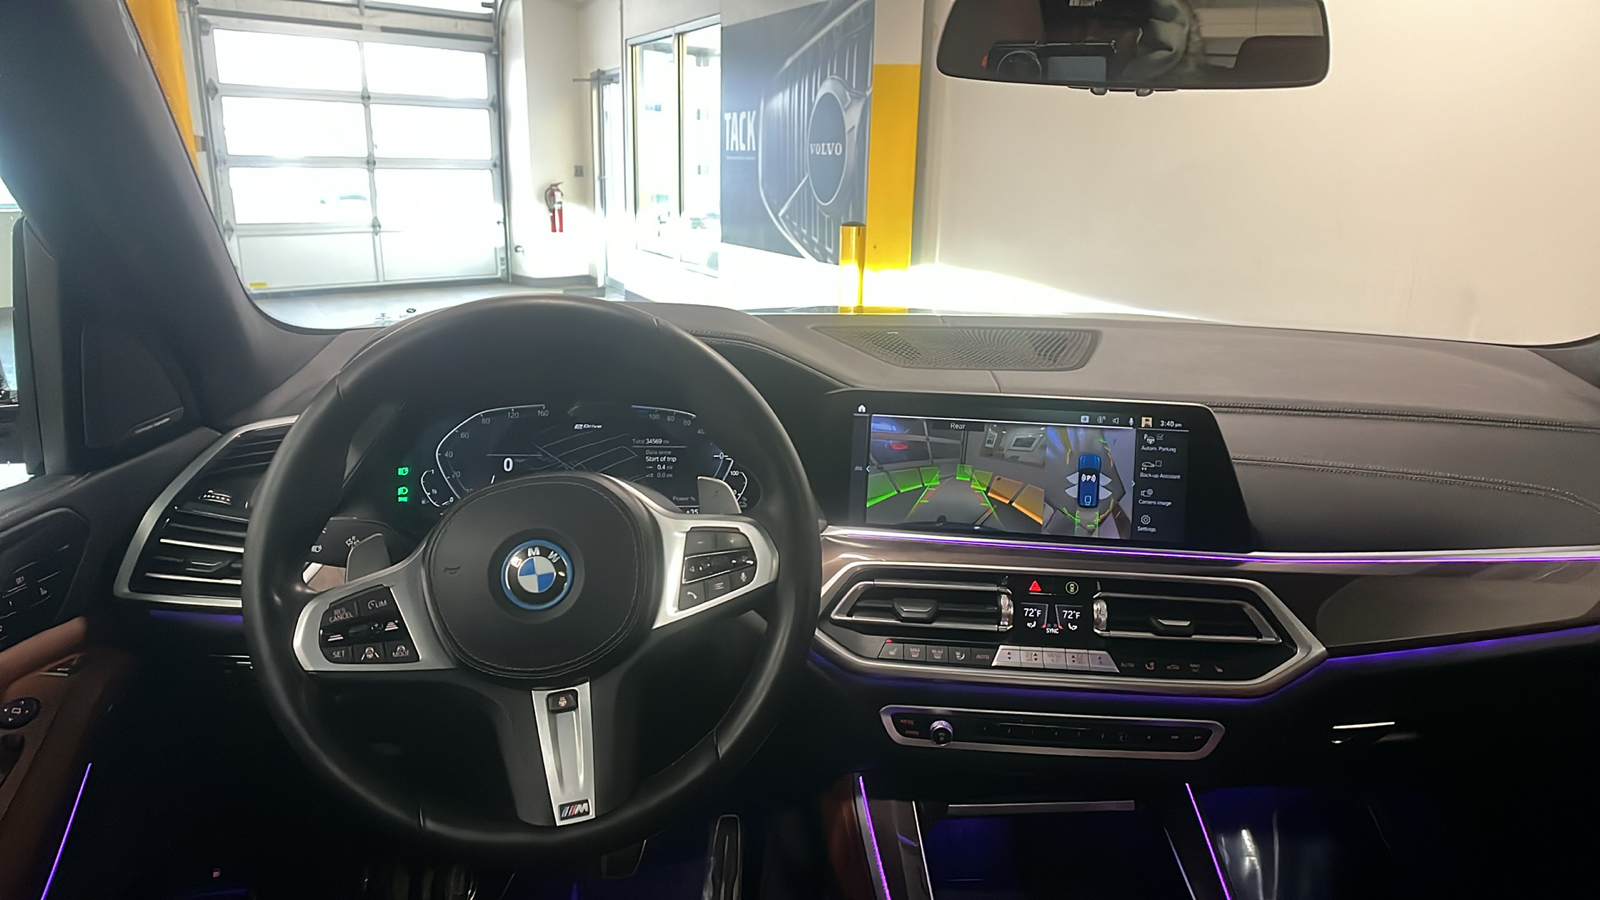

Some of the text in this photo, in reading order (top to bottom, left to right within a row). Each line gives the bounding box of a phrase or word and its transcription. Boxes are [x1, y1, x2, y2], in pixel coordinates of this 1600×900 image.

[724, 110, 757, 152] TACK
[809, 142, 843, 156] VOLVO
[507, 411, 520, 419] 120
[481, 417, 491, 425] 80
[1160, 420, 1175, 428] 3:40
[950, 422, 966, 430] Rear
[444, 450, 454, 458] 40
[503, 457, 514, 472] 0
[667, 456, 678, 464] trip
[510, 546, 560, 568] BMW
[328, 611, 354, 623] CANCEL
[332, 649, 346, 659] SET
